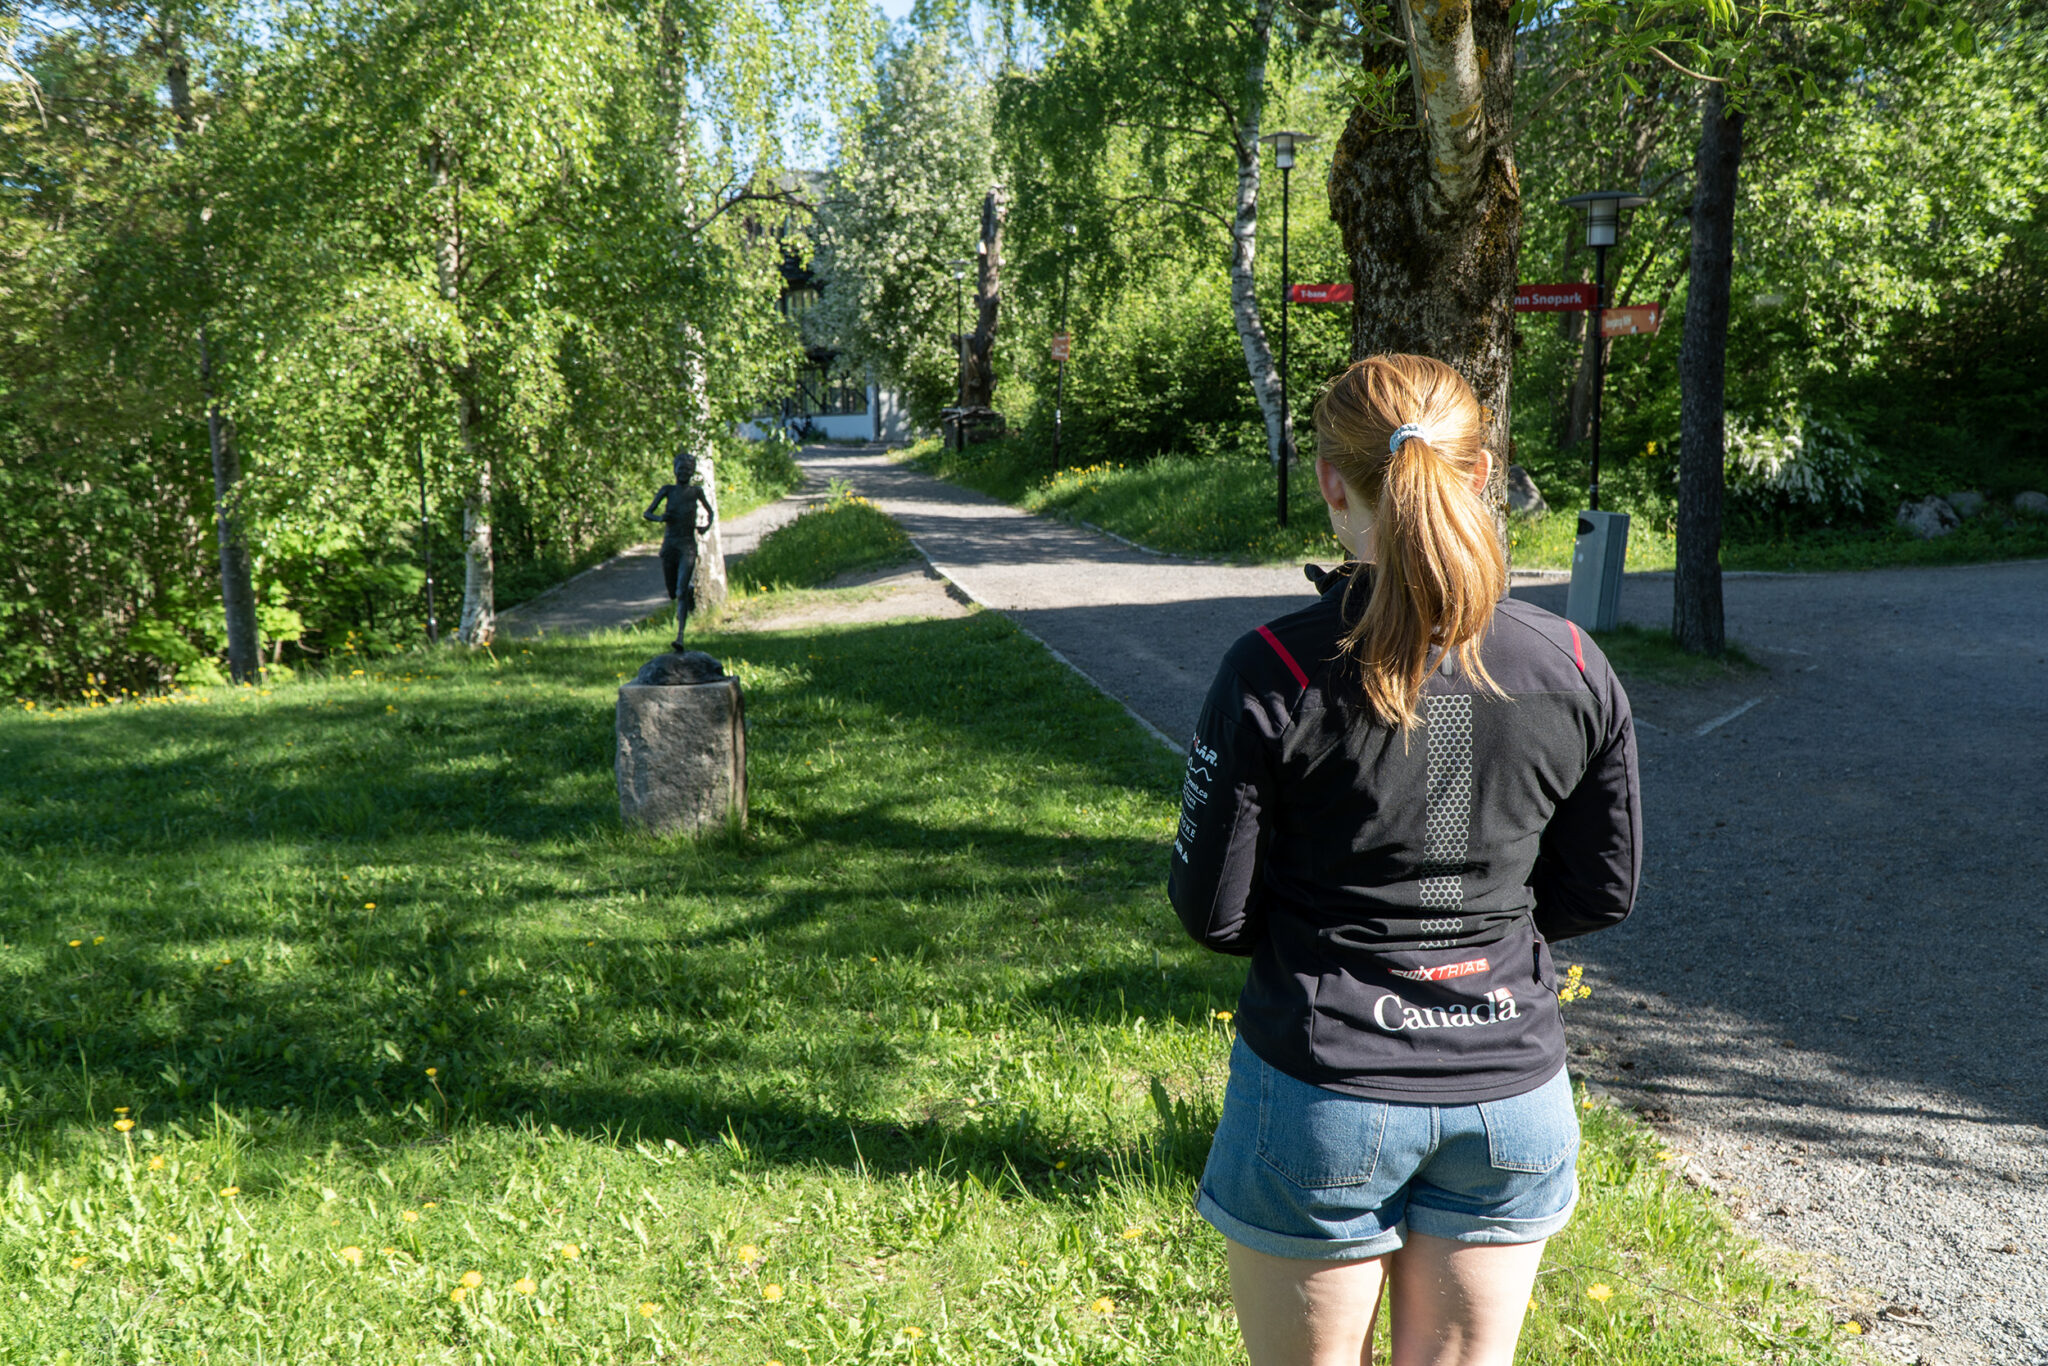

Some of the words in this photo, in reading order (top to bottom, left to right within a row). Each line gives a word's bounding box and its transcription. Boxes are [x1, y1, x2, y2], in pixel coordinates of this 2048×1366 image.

[1300, 290, 1327, 298] T-bane
[1532, 292, 1582, 306] Snøpark
[1373, 990, 1521, 1031] Canada
